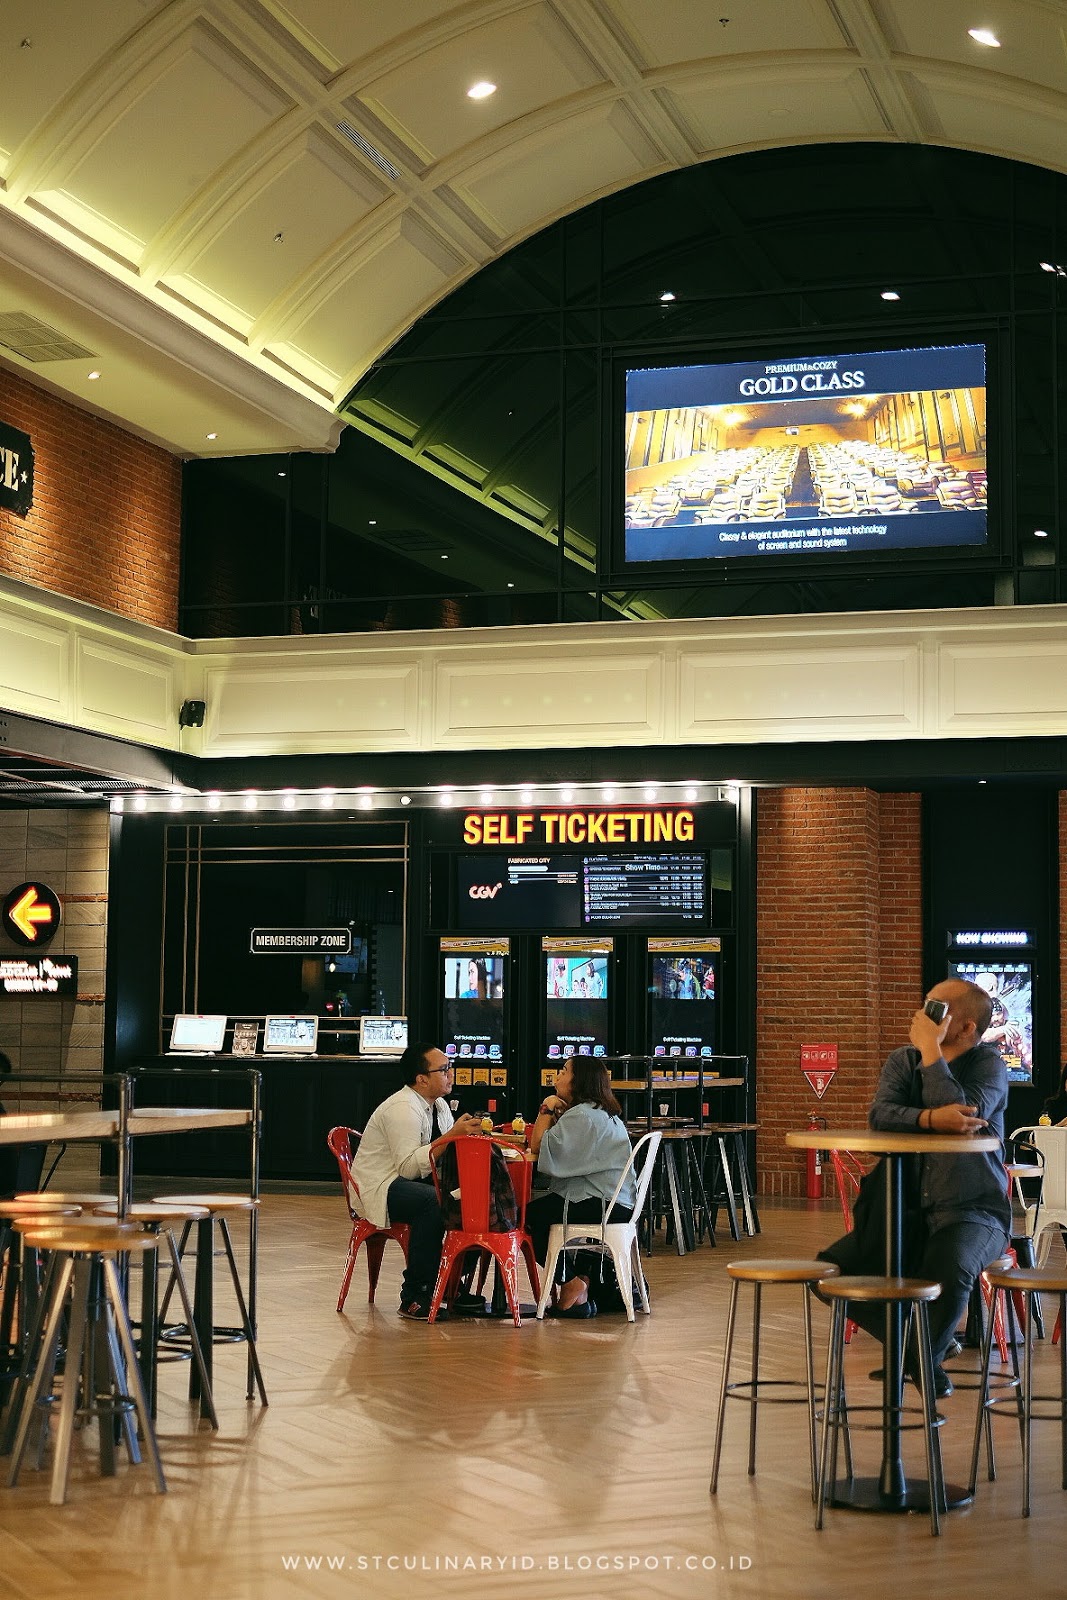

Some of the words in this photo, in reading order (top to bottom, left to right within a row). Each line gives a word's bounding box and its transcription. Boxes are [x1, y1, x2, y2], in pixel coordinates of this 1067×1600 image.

[740, 376, 798, 396] GOLD
[801, 371, 865, 391] CLASS
[719, 532, 739, 542] Classy
[741, 531, 747, 540] &
[748, 530, 771, 541] elegant
[772, 529, 805, 539] auditorium
[807, 528, 820, 537] with
[821, 527, 832, 536] the
[833, 526, 851, 535] latest
[852, 524, 887, 535] technology
[758, 542, 766, 550] of
[766, 541, 788, 550] screen
[788, 540, 801, 549] and
[803, 539, 822, 548] sound
[823, 538, 847, 548] system
[463, 814, 534, 845] SELF
[540, 812, 695, 843] TICKETING
[625, 864, 643, 872] Show
[469, 885, 500, 899] CGV
[255, 935, 319, 946] MEMBERSHIP
[320, 935, 346, 946] ZONE
